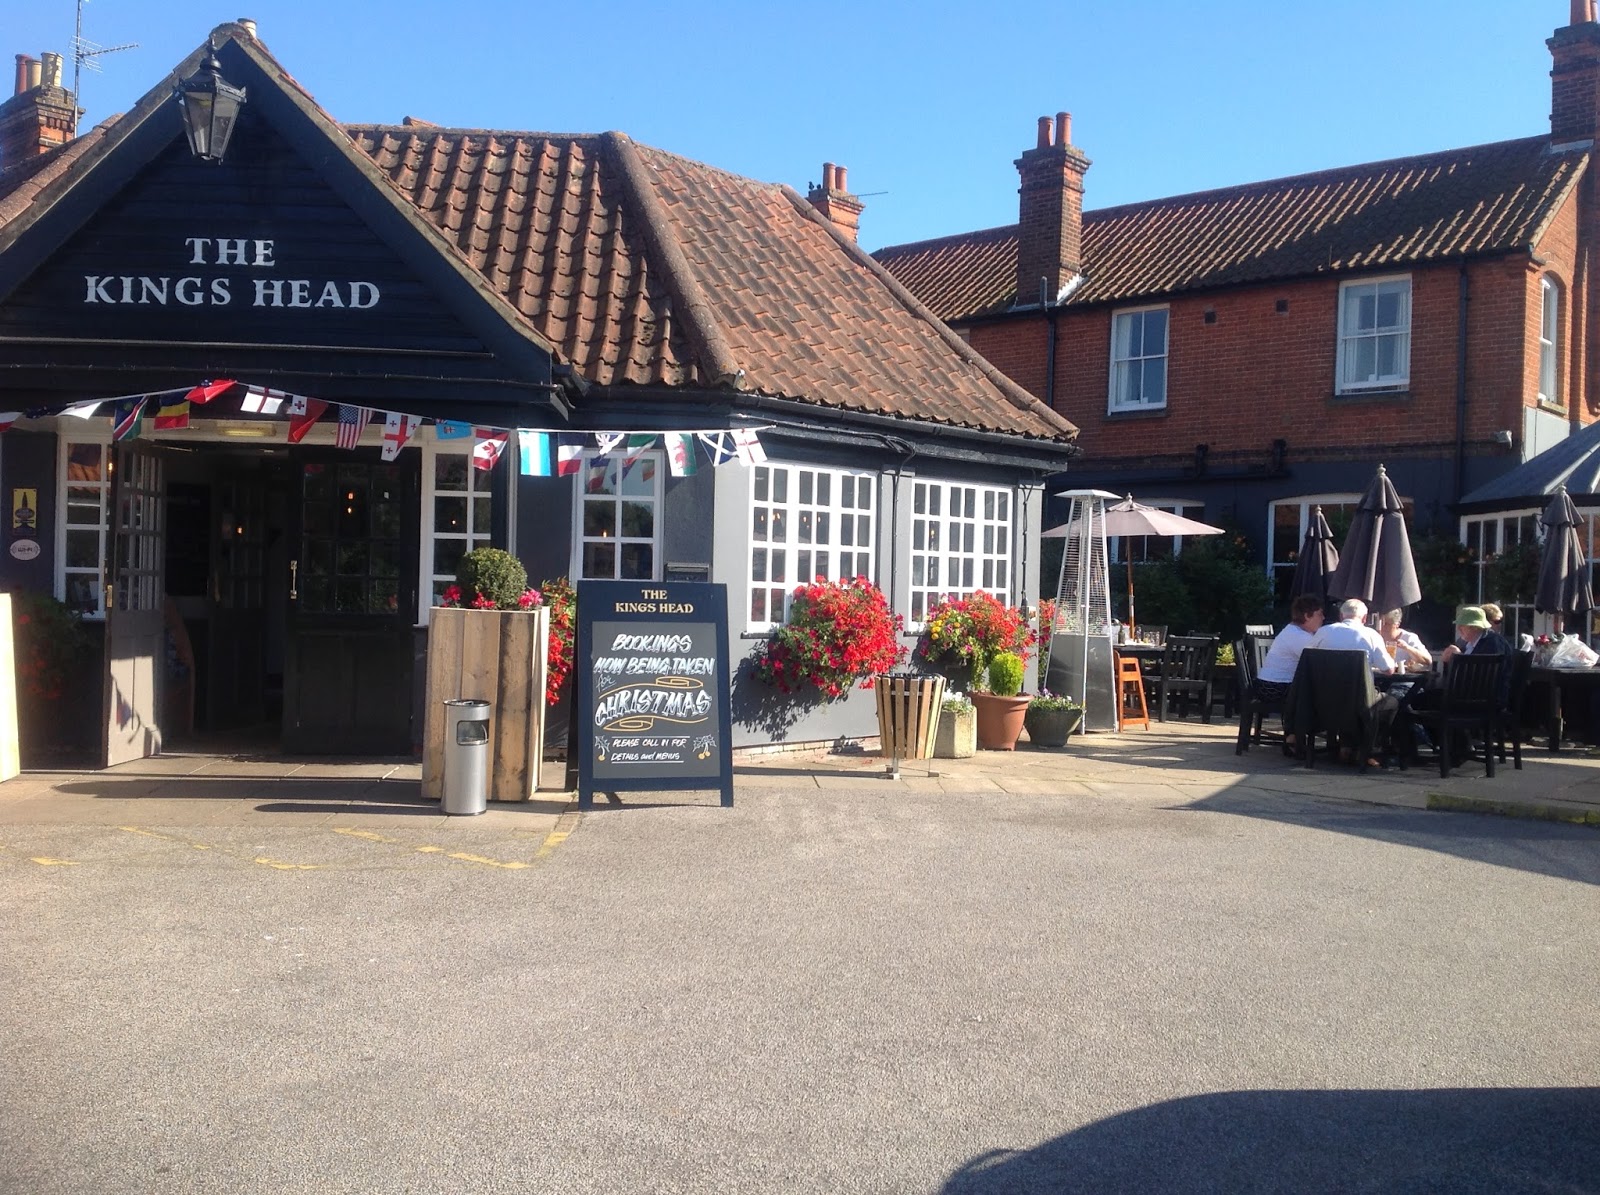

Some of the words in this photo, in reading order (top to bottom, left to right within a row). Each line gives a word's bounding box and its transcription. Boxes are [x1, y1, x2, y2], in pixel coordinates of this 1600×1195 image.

[185, 237, 275, 266] THE
[84, 275, 231, 305] KINGS
[252, 279, 380, 308] HEAD
[641, 590, 667, 600] THE
[615, 603, 656, 613] KINGS
[659, 603, 694, 614] HEAD
[611, 634, 692, 653] BOOKINGS
[593, 657, 626, 674] NOW
[627, 656, 669, 675] BEING
[672, 657, 716, 675] TAKEN
[597, 674, 616, 692] for
[595, 690, 712, 726] CHRISTMAS
[612, 739, 640, 747] PLEASE
[642, 738, 659, 748] CALL
[661, 739, 669, 747] IN
[671, 738, 688, 748] FOR
[611, 752, 639, 762] DETAILS
[640, 751, 656, 761] and
[655, 752, 681, 761] MENUS
